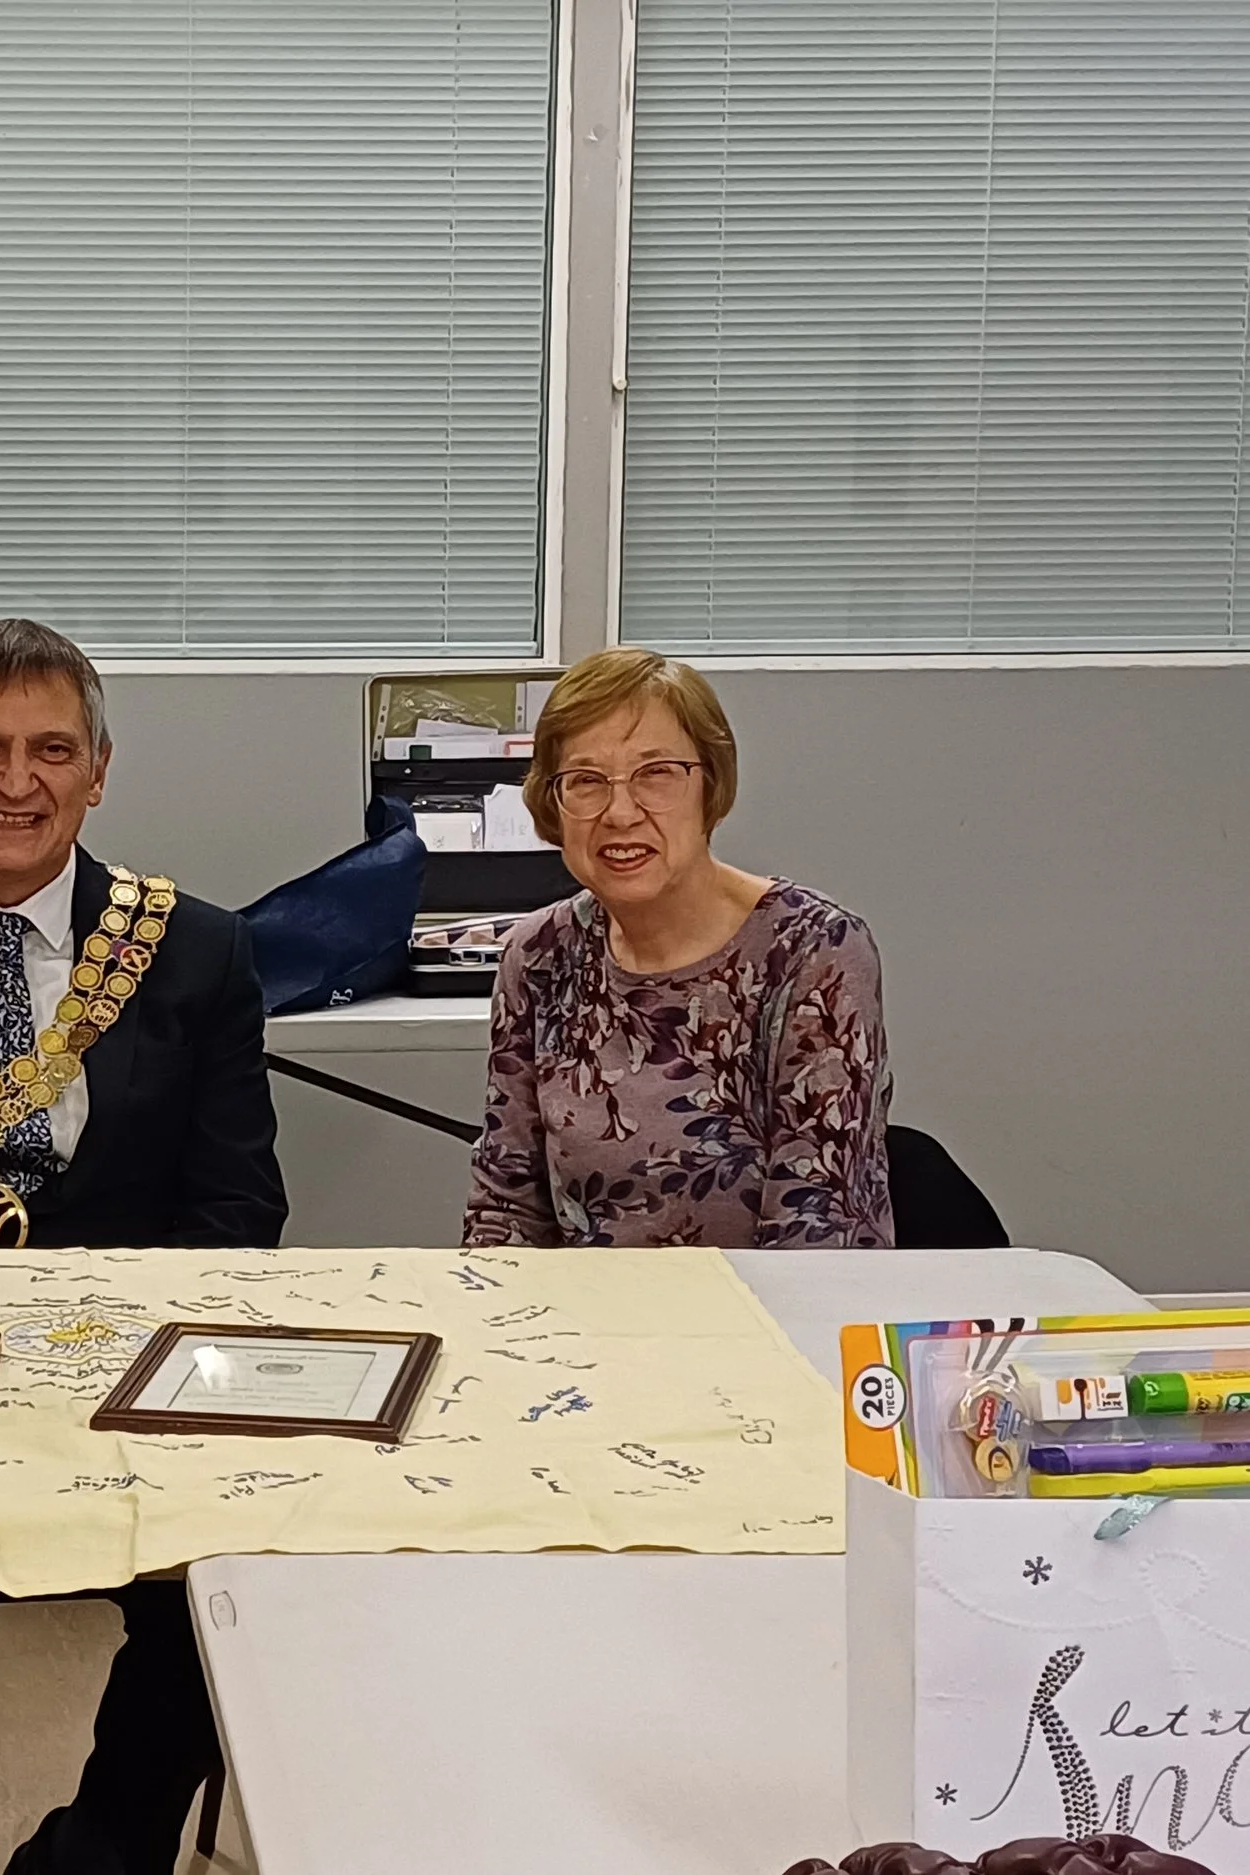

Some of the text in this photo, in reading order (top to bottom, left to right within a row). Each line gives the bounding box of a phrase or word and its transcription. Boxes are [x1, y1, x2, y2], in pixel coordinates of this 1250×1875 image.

[860, 1376, 884, 1419] 20
[884, 1377, 896, 1416] PIECES
[1099, 1700, 1250, 1737] let it
